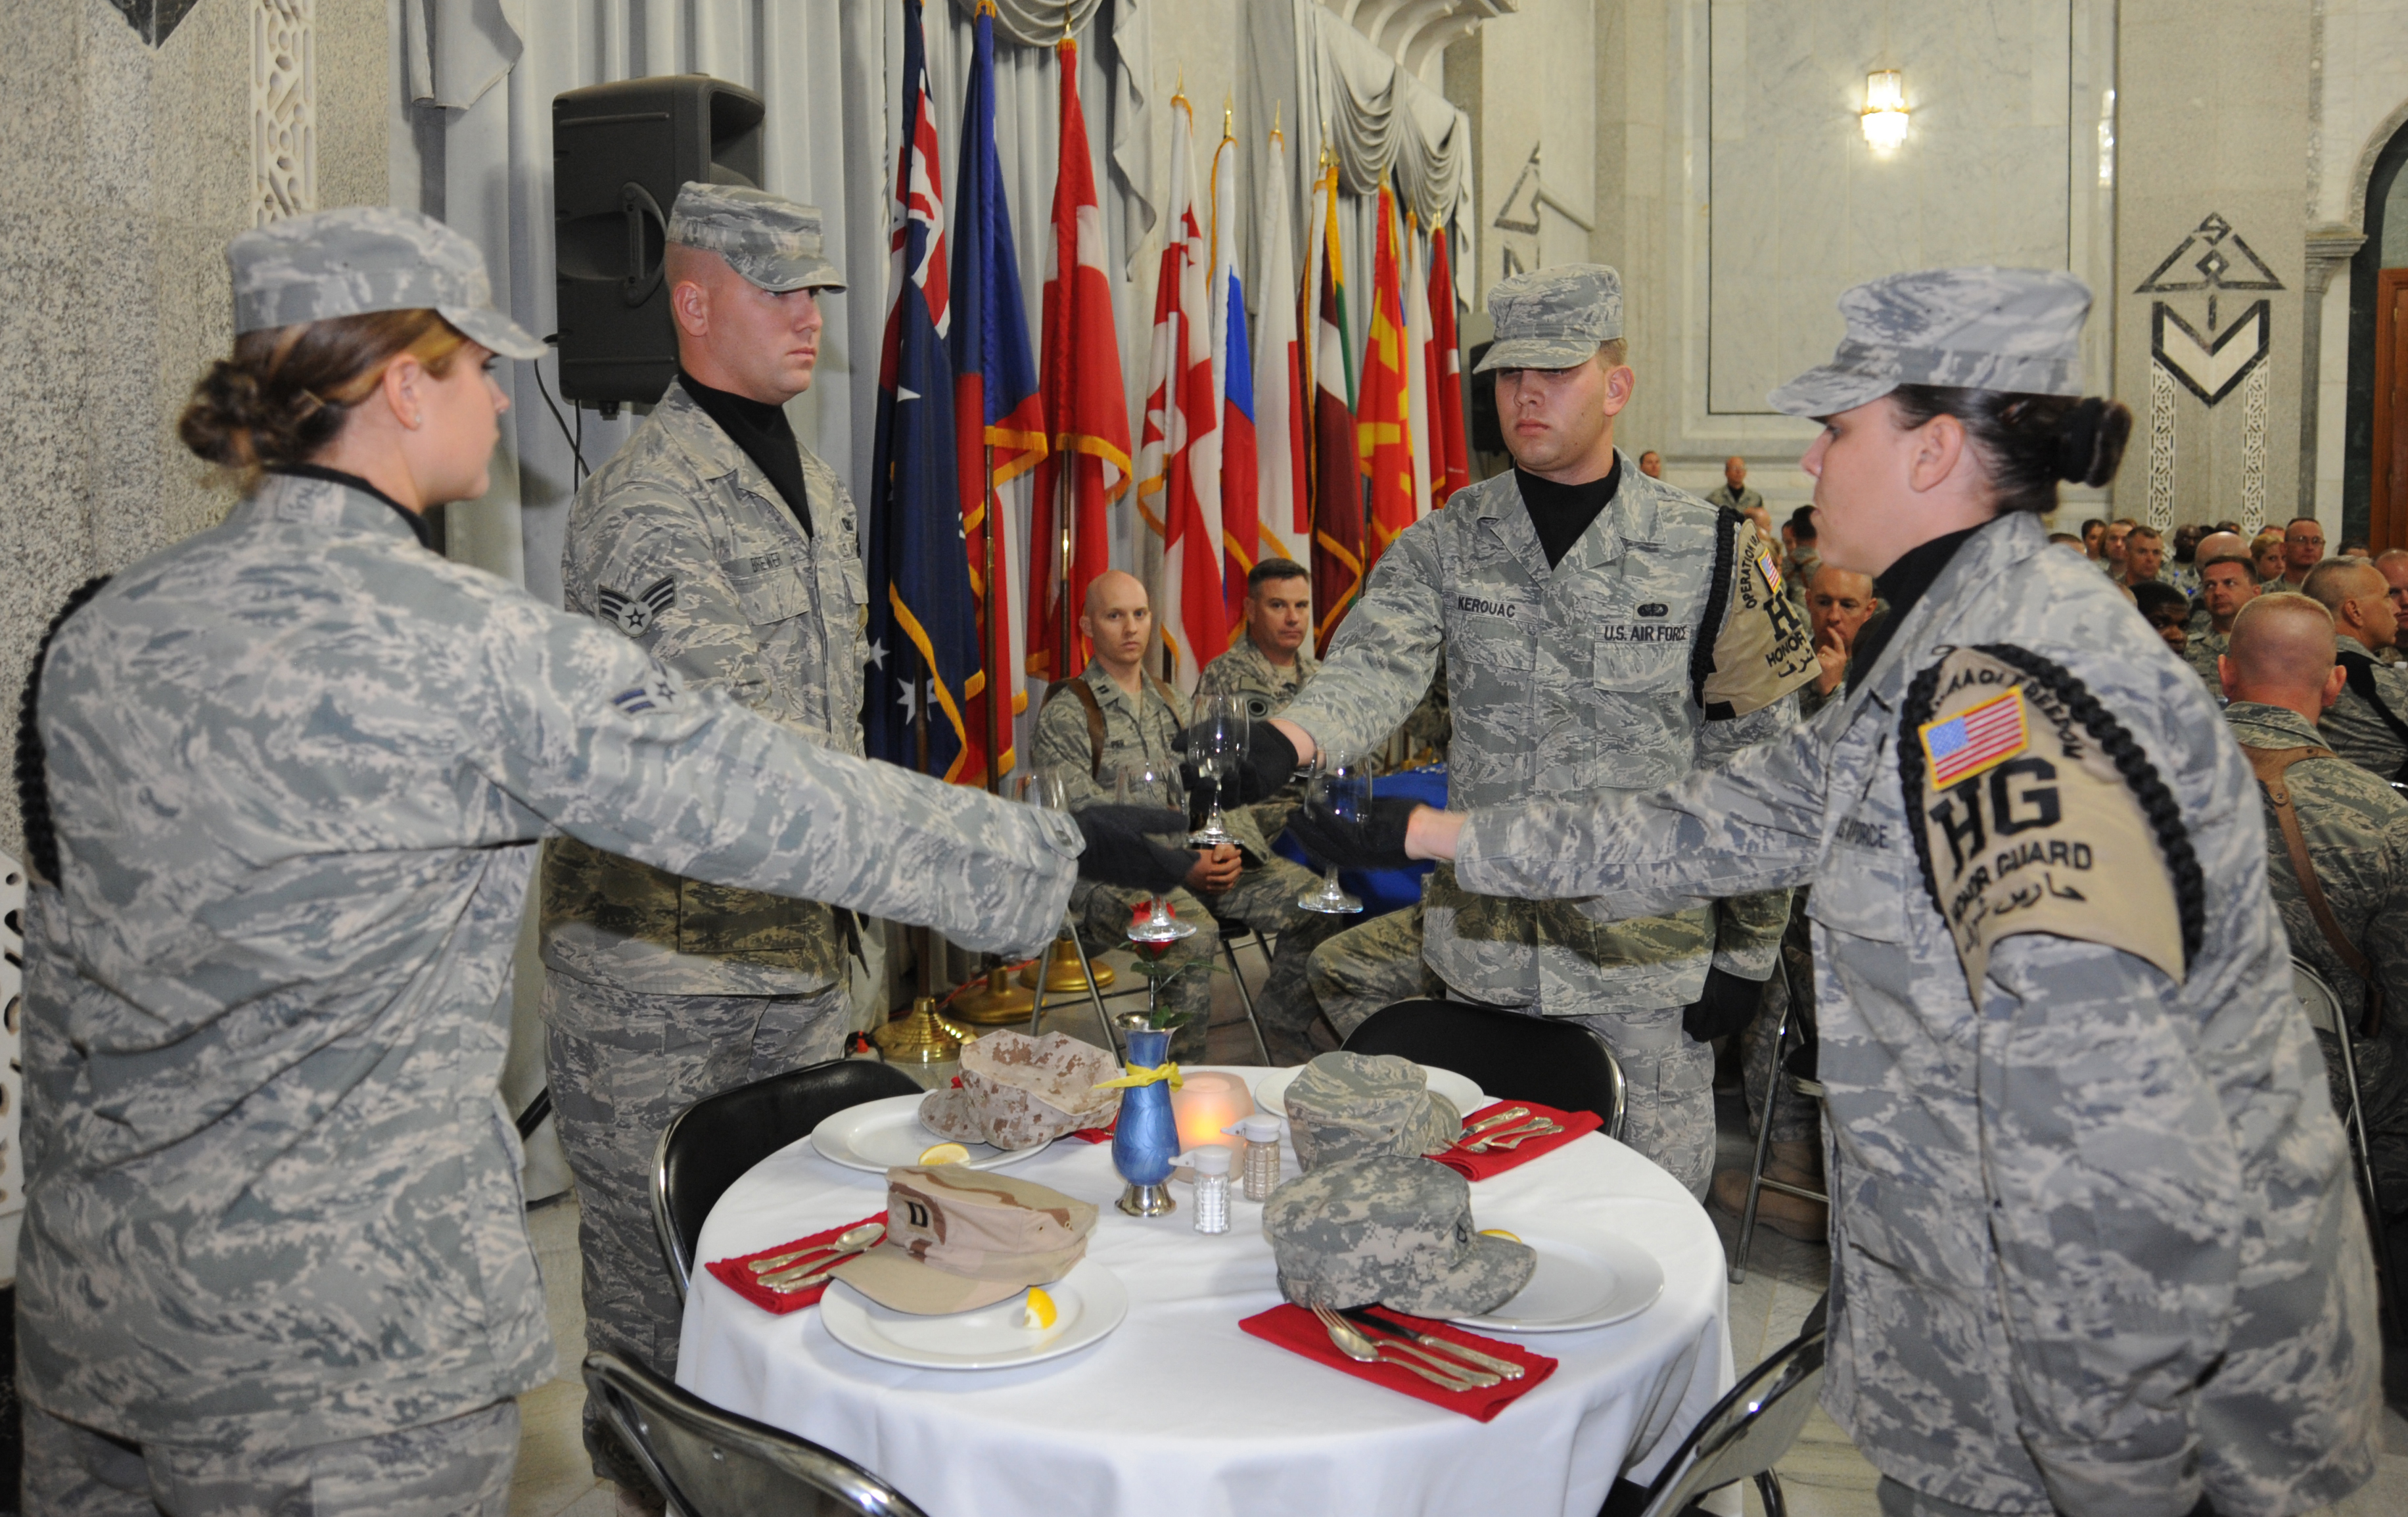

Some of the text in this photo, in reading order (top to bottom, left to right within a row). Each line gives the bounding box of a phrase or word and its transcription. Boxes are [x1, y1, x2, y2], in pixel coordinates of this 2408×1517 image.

[750, 552, 783, 572] BREWER
[1740, 542, 1758, 609] OPERATION
[1458, 595, 1516, 618] KEROUAC
[1604, 625, 1687, 642] U.S. AIR FORCE
[1765, 632, 1807, 668] HONOR
[1930, 758, 2062, 882] HG
[1997, 840, 2093, 879] GUARD
